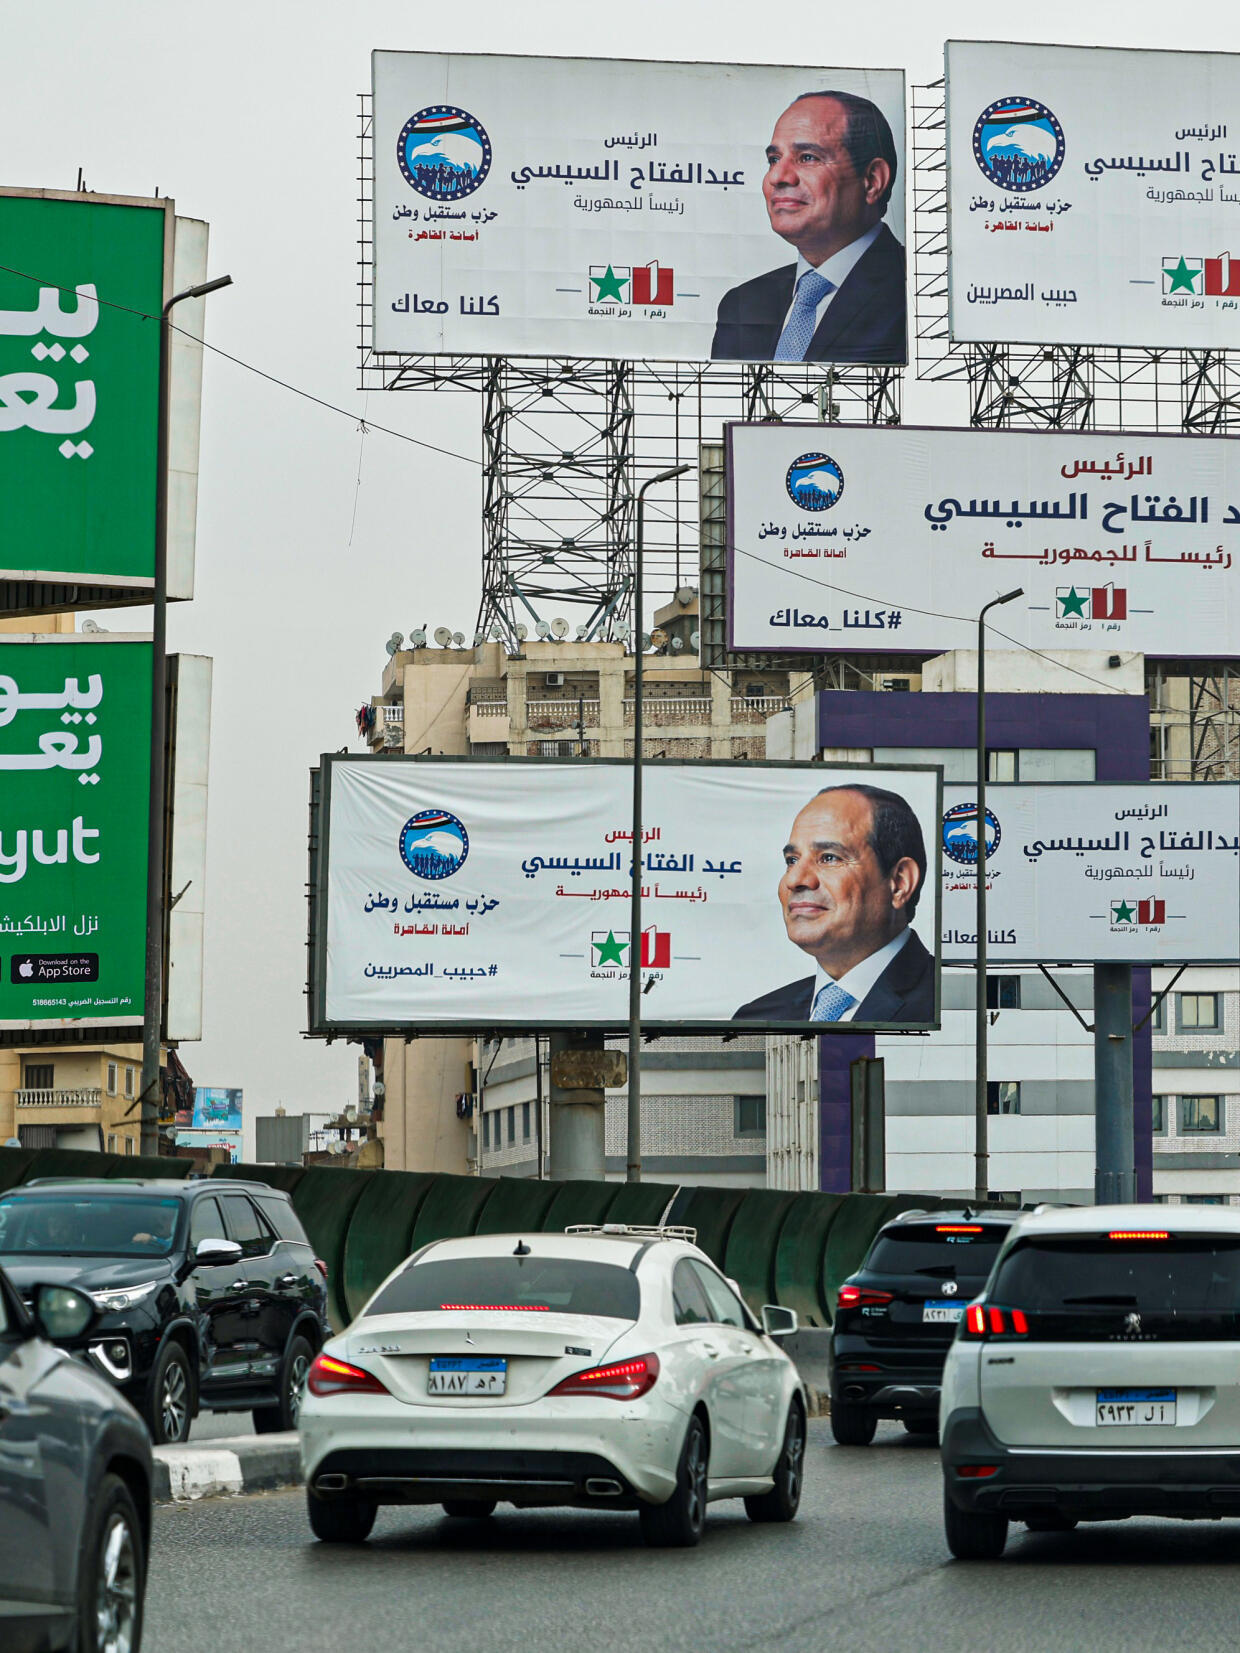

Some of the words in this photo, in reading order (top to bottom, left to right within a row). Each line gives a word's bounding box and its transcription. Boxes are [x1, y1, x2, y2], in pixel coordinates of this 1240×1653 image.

[604, 132, 657, 150] الرئيس
[1175, 124, 1227, 142] الرئيس
[511, 160, 618, 189] السيسي
[1085, 152, 1189, 181] السيسي
[573, 194, 643, 213] للجمهورية
[969, 195, 995, 213] وطن
[1146, 186, 1214, 205] للجمهورية
[392, 204, 419, 221] وطن
[423, 204, 467, 223] مستقبل
[471, 205, 499, 224] حزب
[999, 197, 1042, 214] مستقبل
[1046, 198, 1073, 215] حزب
[407, 228, 446, 242] القاهرة
[449, 228, 479, 242] أمانة
[984, 219, 1022, 233] القاهرة
[1025, 219, 1055, 232] أمانة
[967, 283, 1034, 304] المصريين
[1041, 288, 1078, 307] حبيب
[392, 294, 449, 314] معاك
[460, 295, 500, 316] كلنا
[1061, 453, 1152, 480] الرئيس
[925, 493, 1087, 531] السيسي
[1102, 495, 1208, 533] الفتاح
[758, 522, 786, 540] وطن
[791, 522, 838, 541] مستقبل
[842, 523, 872, 541] حزب
[1115, 804, 1167, 820] الرئيس
[1024, 831, 1128, 862] السيسي
[522, 852, 620, 878] السيسي
[702, 858, 742, 879] عبد
[1085, 865, 1153, 880] للجمهورية
[364, 892, 398, 913] وطن
[405, 892, 459, 914] مستقبل
[466, 894, 500, 915] حزب
[74, 915, 98, 935] نزل
[394, 923, 438, 936] القاهرة
[441, 923, 470, 936] أمانة
[988, 929, 1016, 944] كلنا
[39, 967, 60, 978] App
[62, 966, 91, 976] Store
